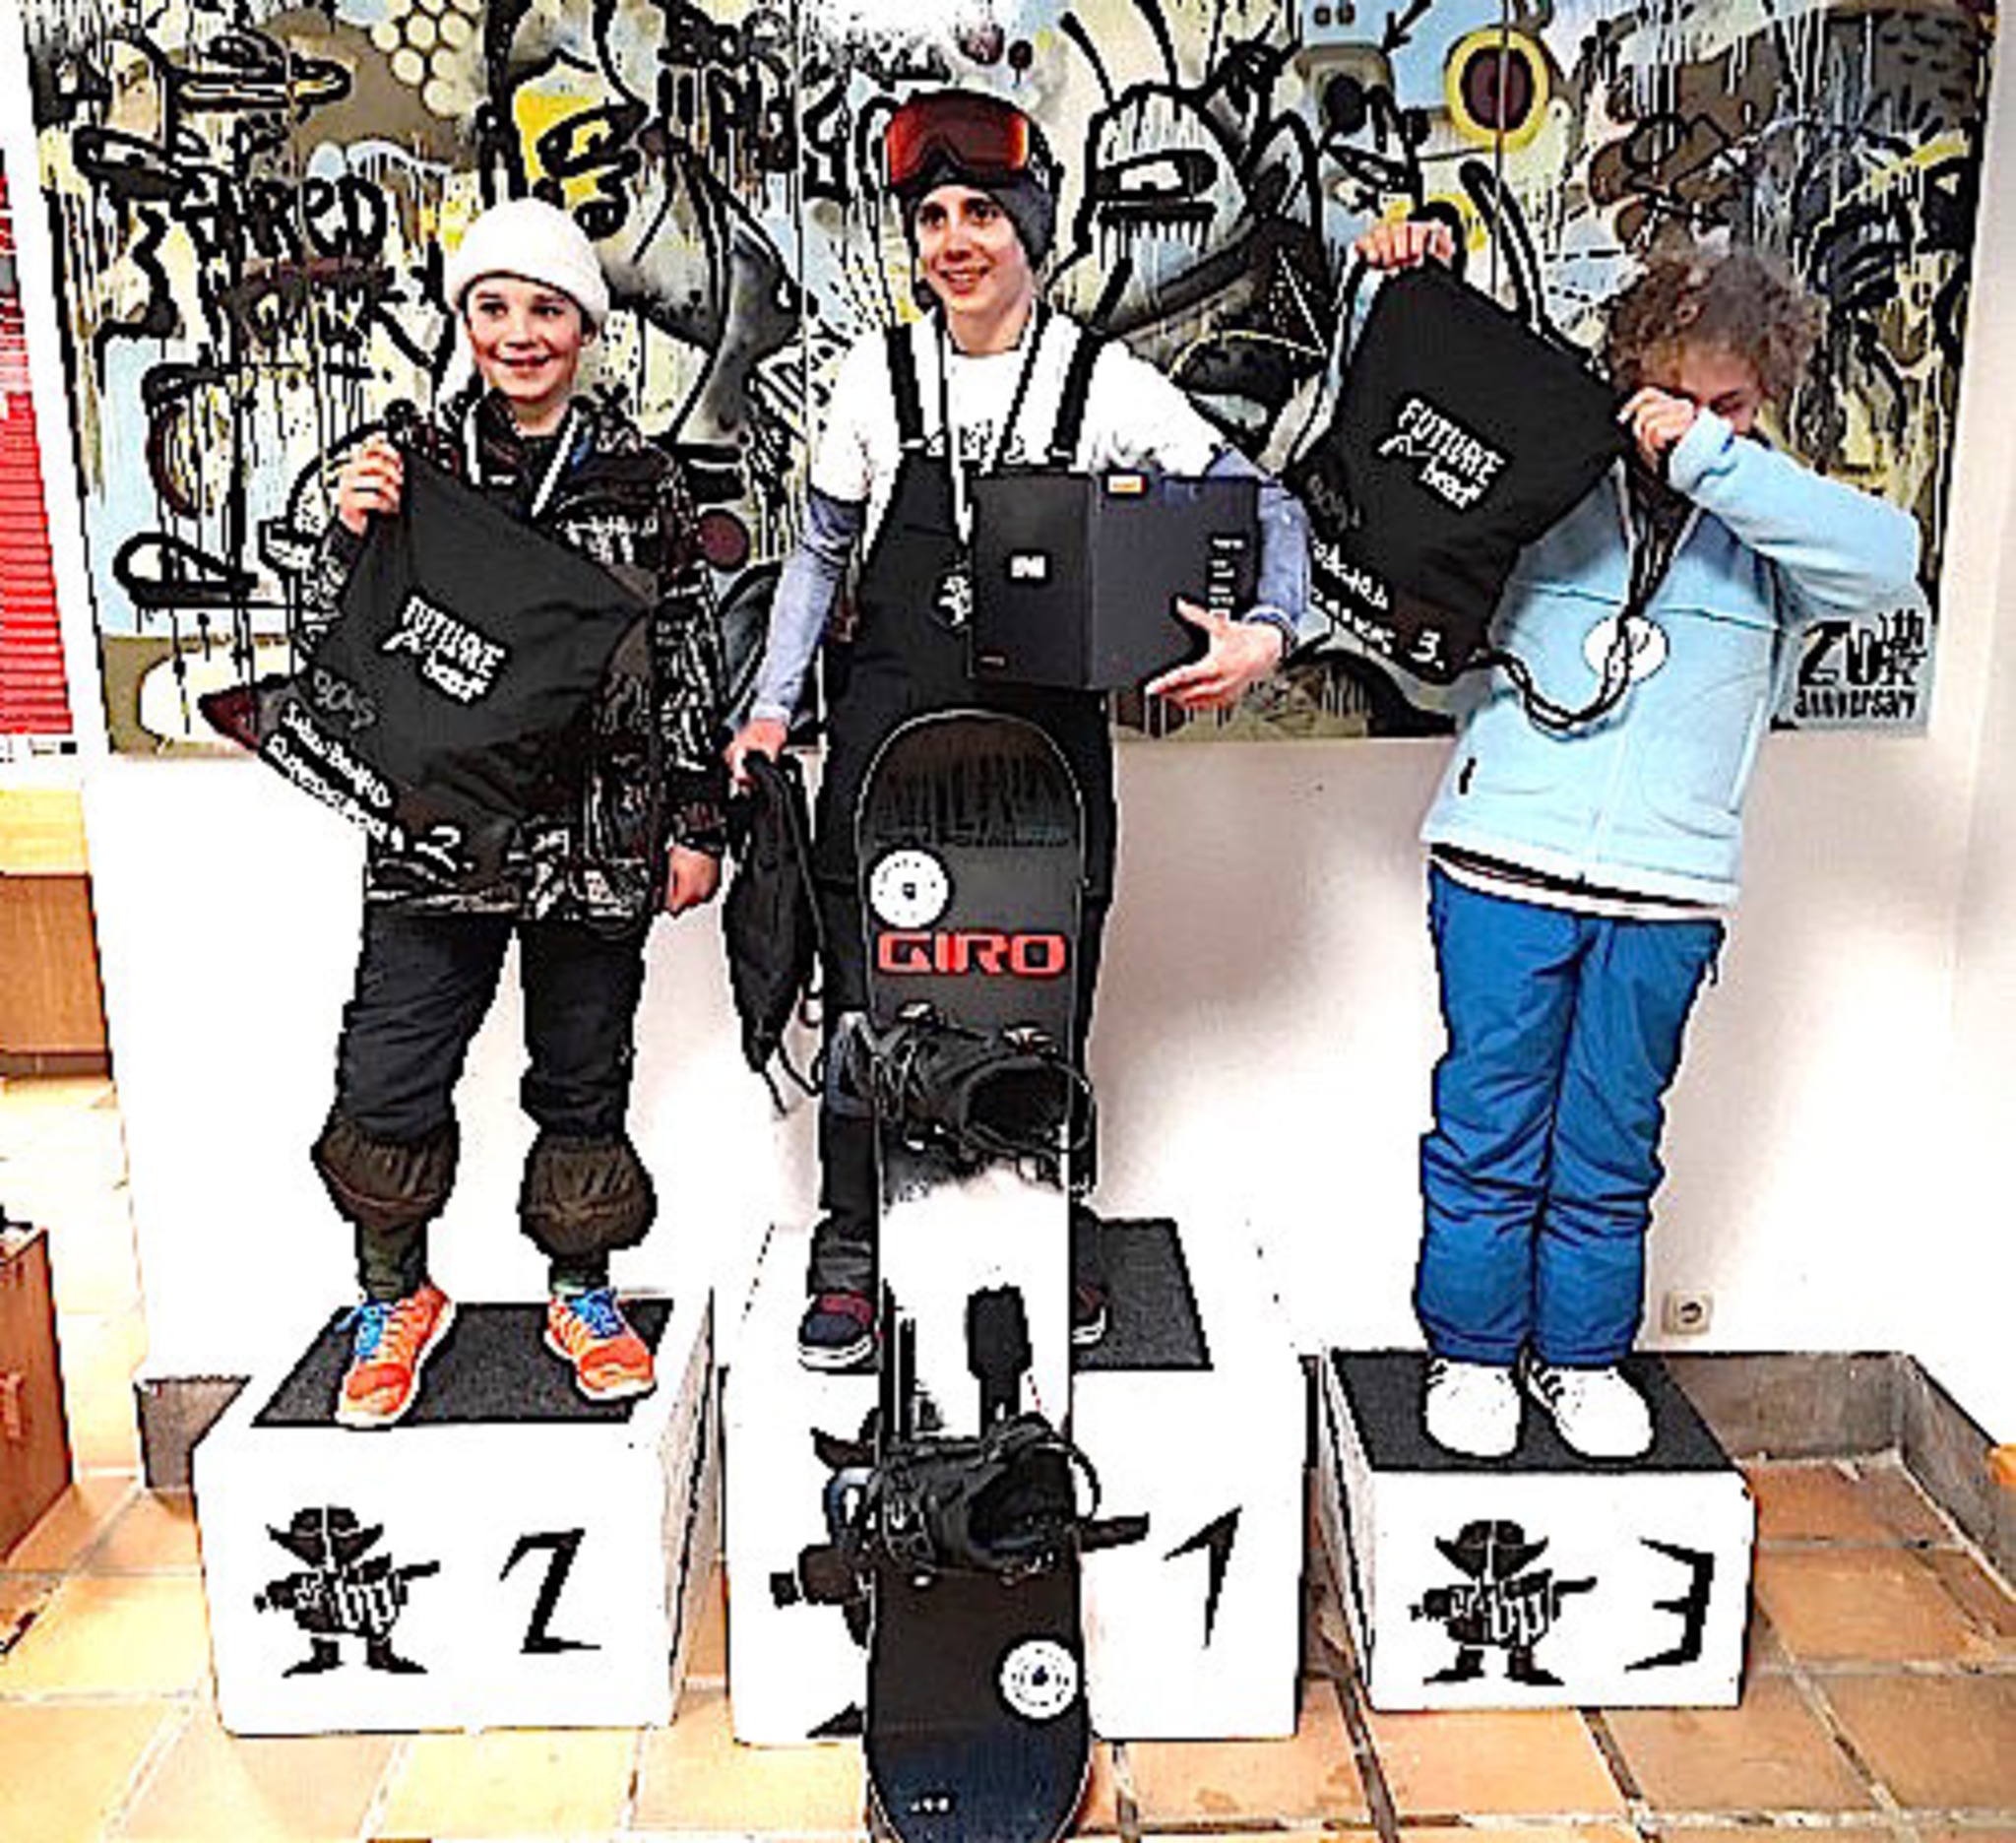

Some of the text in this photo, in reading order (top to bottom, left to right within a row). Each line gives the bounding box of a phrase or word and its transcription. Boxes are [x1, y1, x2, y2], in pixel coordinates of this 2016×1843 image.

[877, 930, 1067, 975] GIRO
[498, 1526, 602, 1655] 2
[1163, 1505, 1243, 1649] 1
[1624, 1535, 1716, 1674] 3
